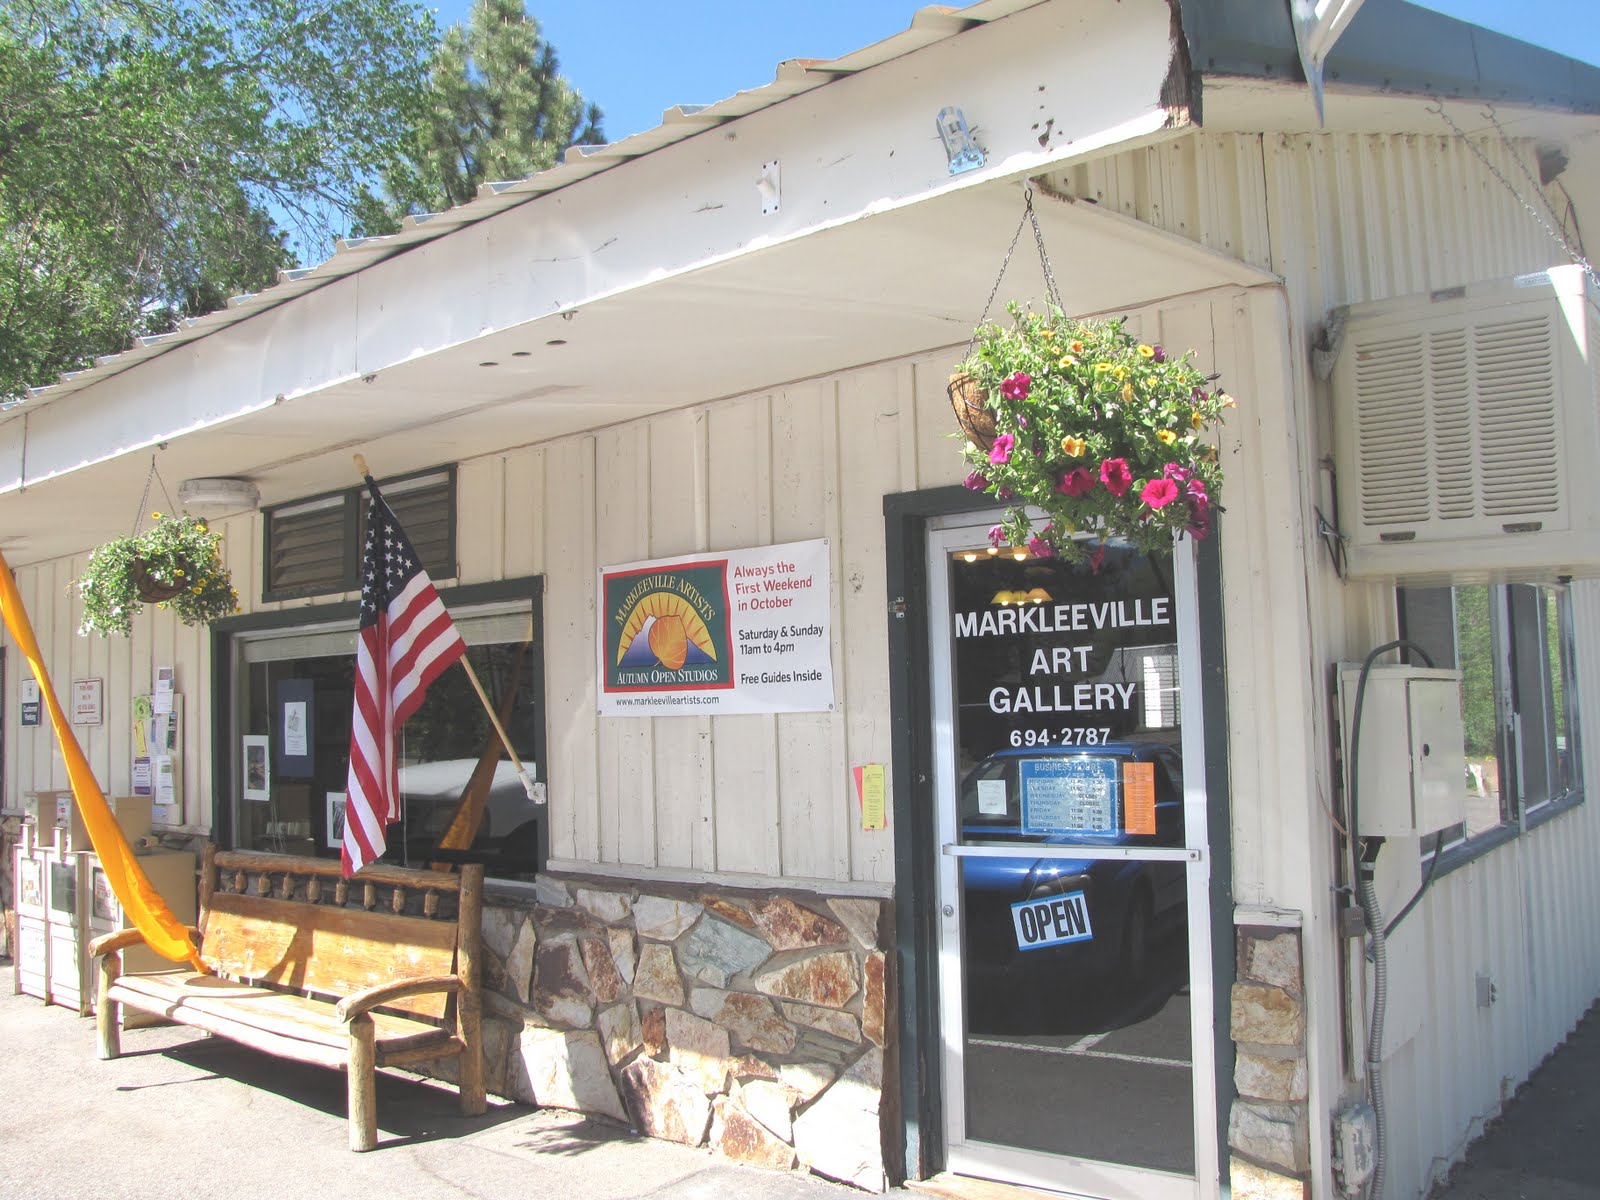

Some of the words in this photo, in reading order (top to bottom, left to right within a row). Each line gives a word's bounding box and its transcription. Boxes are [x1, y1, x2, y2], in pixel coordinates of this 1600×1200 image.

[734, 562, 775, 579] Always
[776, 561, 796, 574] the
[735, 581, 761, 595] First
[764, 576, 812, 592] Weekend
[615, 574, 675, 626] MARKLEEVILLE
[676, 578, 716, 622] ARTISTS
[737, 599, 748, 611] in
[750, 596, 793, 610] October
[955, 597, 1170, 638] MARKLEEVILLE
[738, 627, 779, 641] Saturday
[780, 626, 788, 638] &
[790, 624, 824, 640] Sunday
[740, 644, 761, 655] 11am
[763, 644, 772, 654] to
[773, 641, 795, 656] 4pm
[1029, 645, 1093, 676] ART
[616, 670, 649, 685] AUTUMN
[651, 669, 676, 683] OPEN
[677, 668, 718, 682] STUDIOS
[740, 673, 760, 685] Free
[761, 670, 791, 684] Guides
[793, 669, 823, 682] Inside
[616, 695, 720, 706] www.markleevilleartists.com
[988, 682, 1136, 714] GALLERY
[1019, 897, 1087, 943] OPEN
